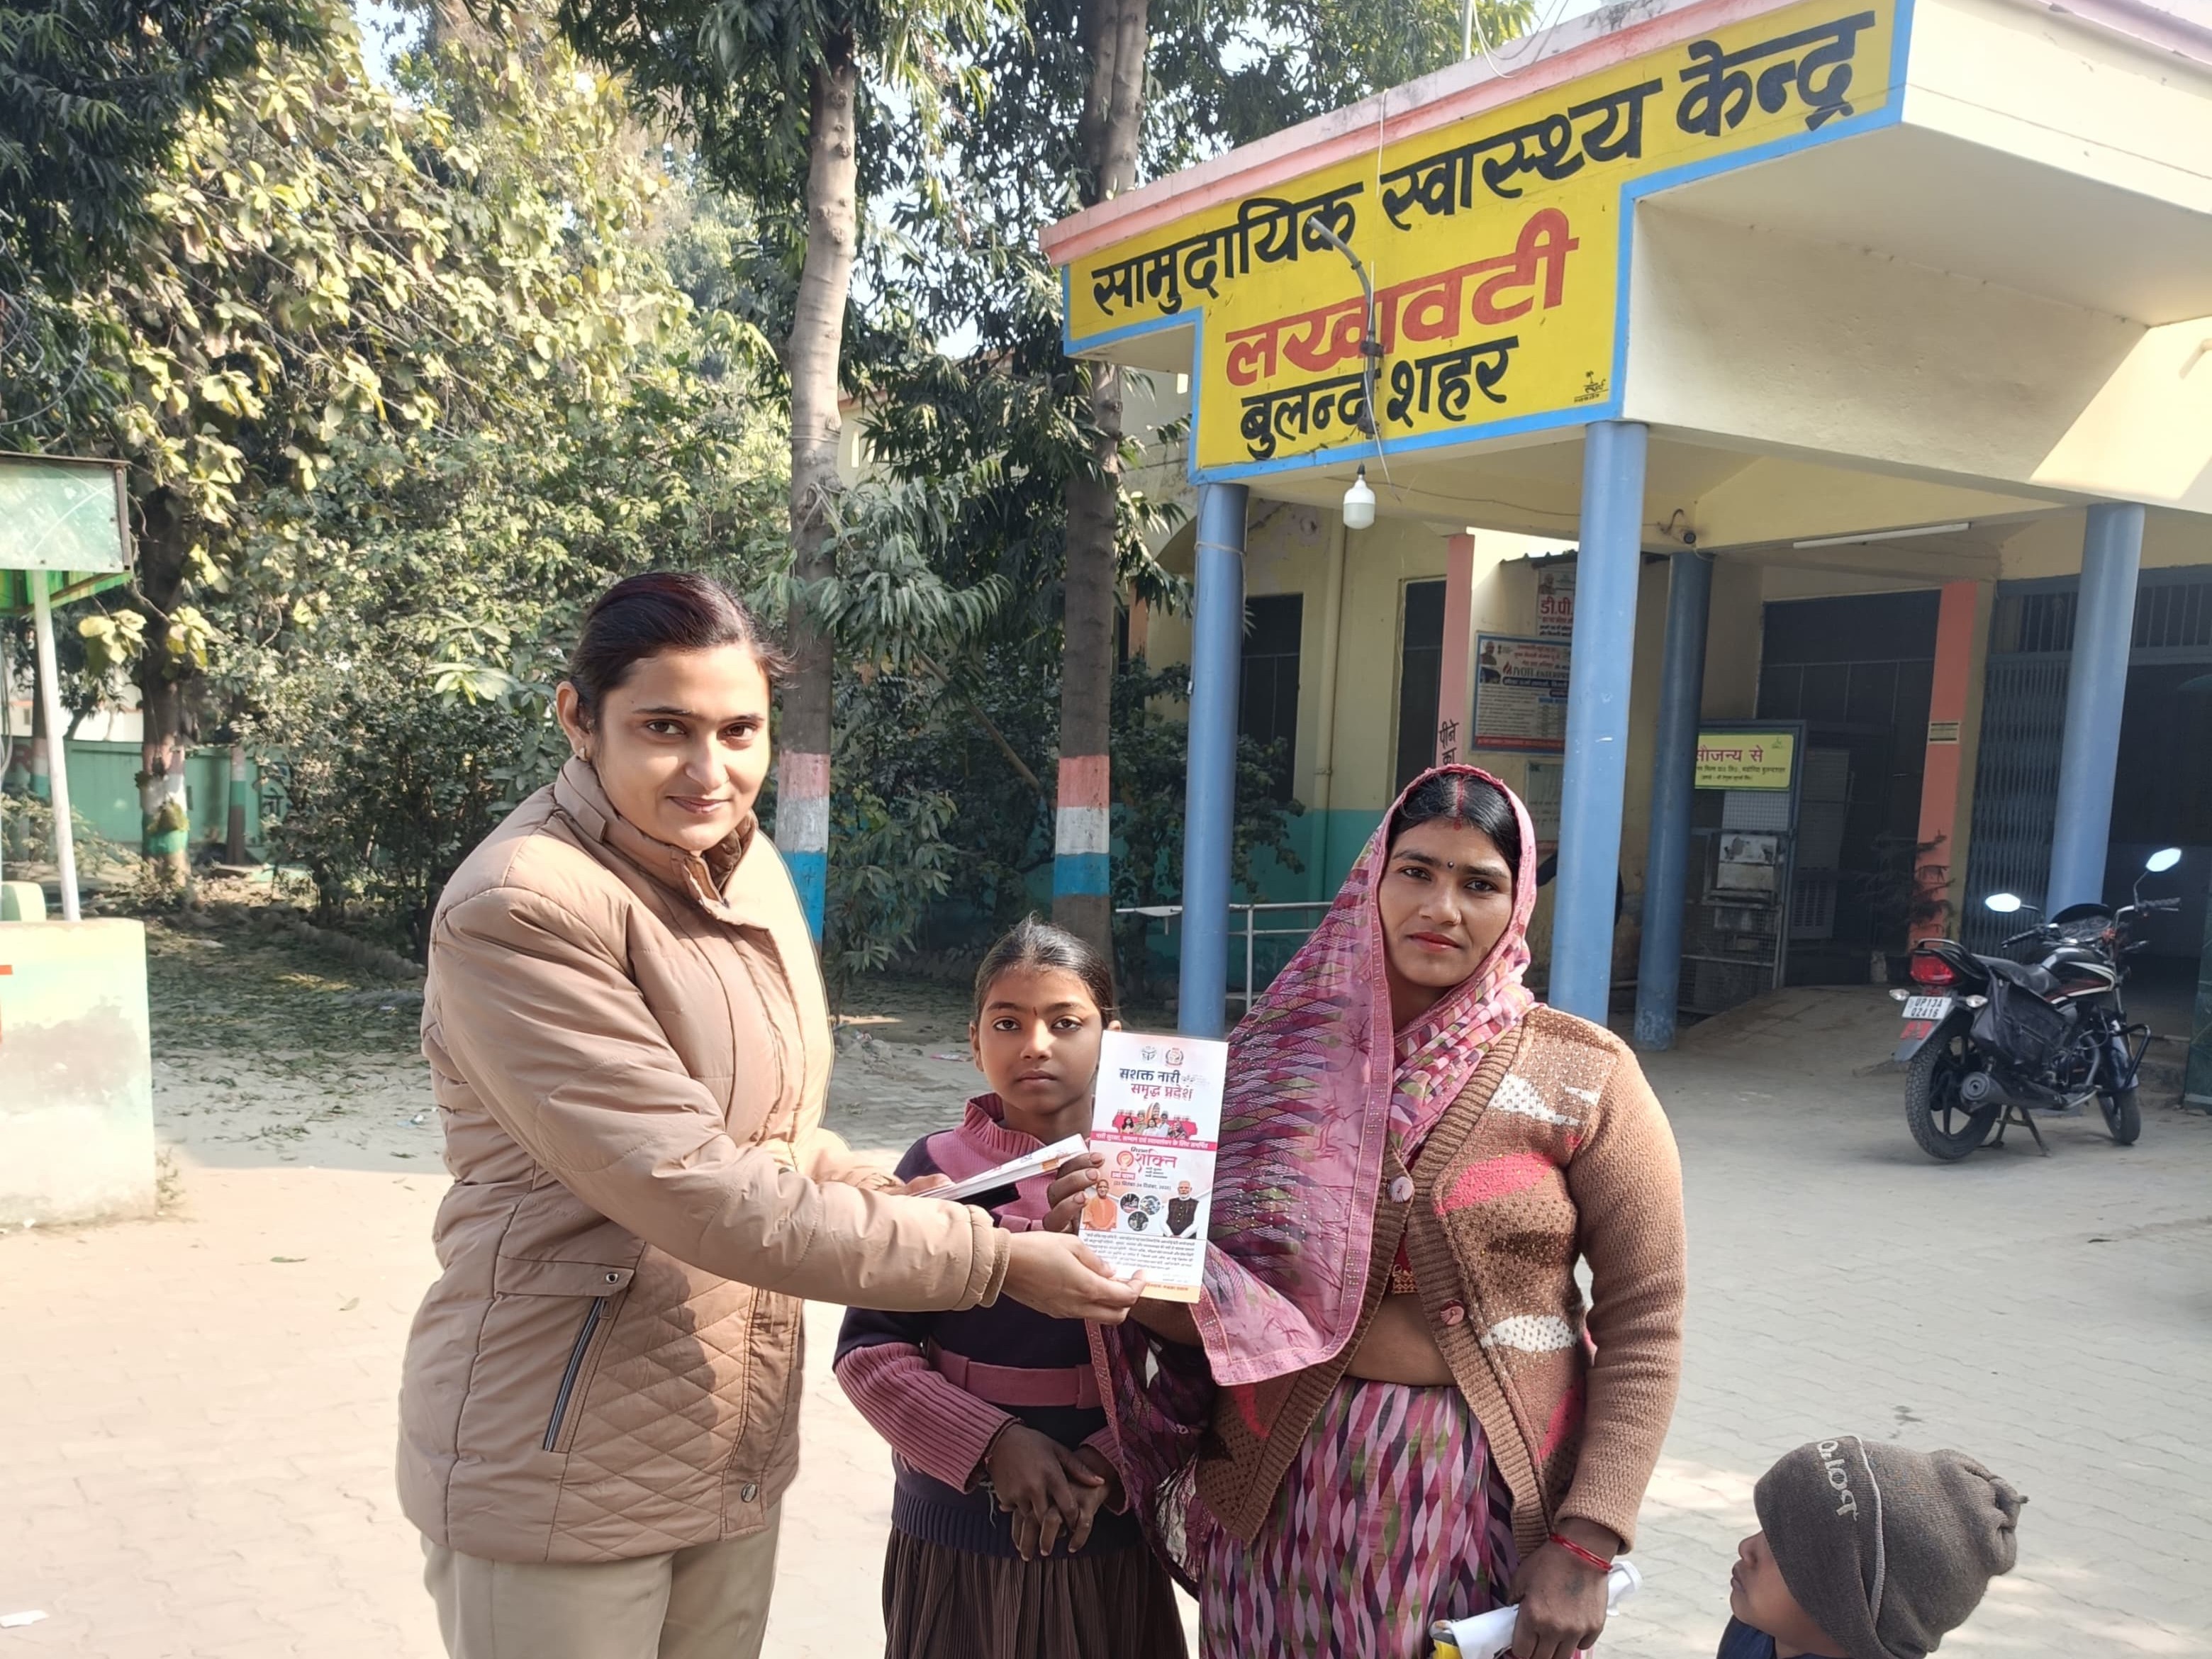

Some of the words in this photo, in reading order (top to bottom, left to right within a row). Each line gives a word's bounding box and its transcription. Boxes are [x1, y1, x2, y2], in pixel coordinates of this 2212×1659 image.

[1091, 181, 1364, 316] सामुदायिक
[1677, 11, 1875, 137] केन्द्र
[1225, 208, 1579, 386] लखावटी
[1439, 718, 1459, 749] पीने
[1748, 744, 1764, 762] से
[1119, 1068, 1154, 1080] सशक्त
[1158, 1069, 1180, 1083] नारी
[1131, 1083, 1161, 1099] समृद्ध
[1165, 1084, 1192, 1100] प्रदेश
